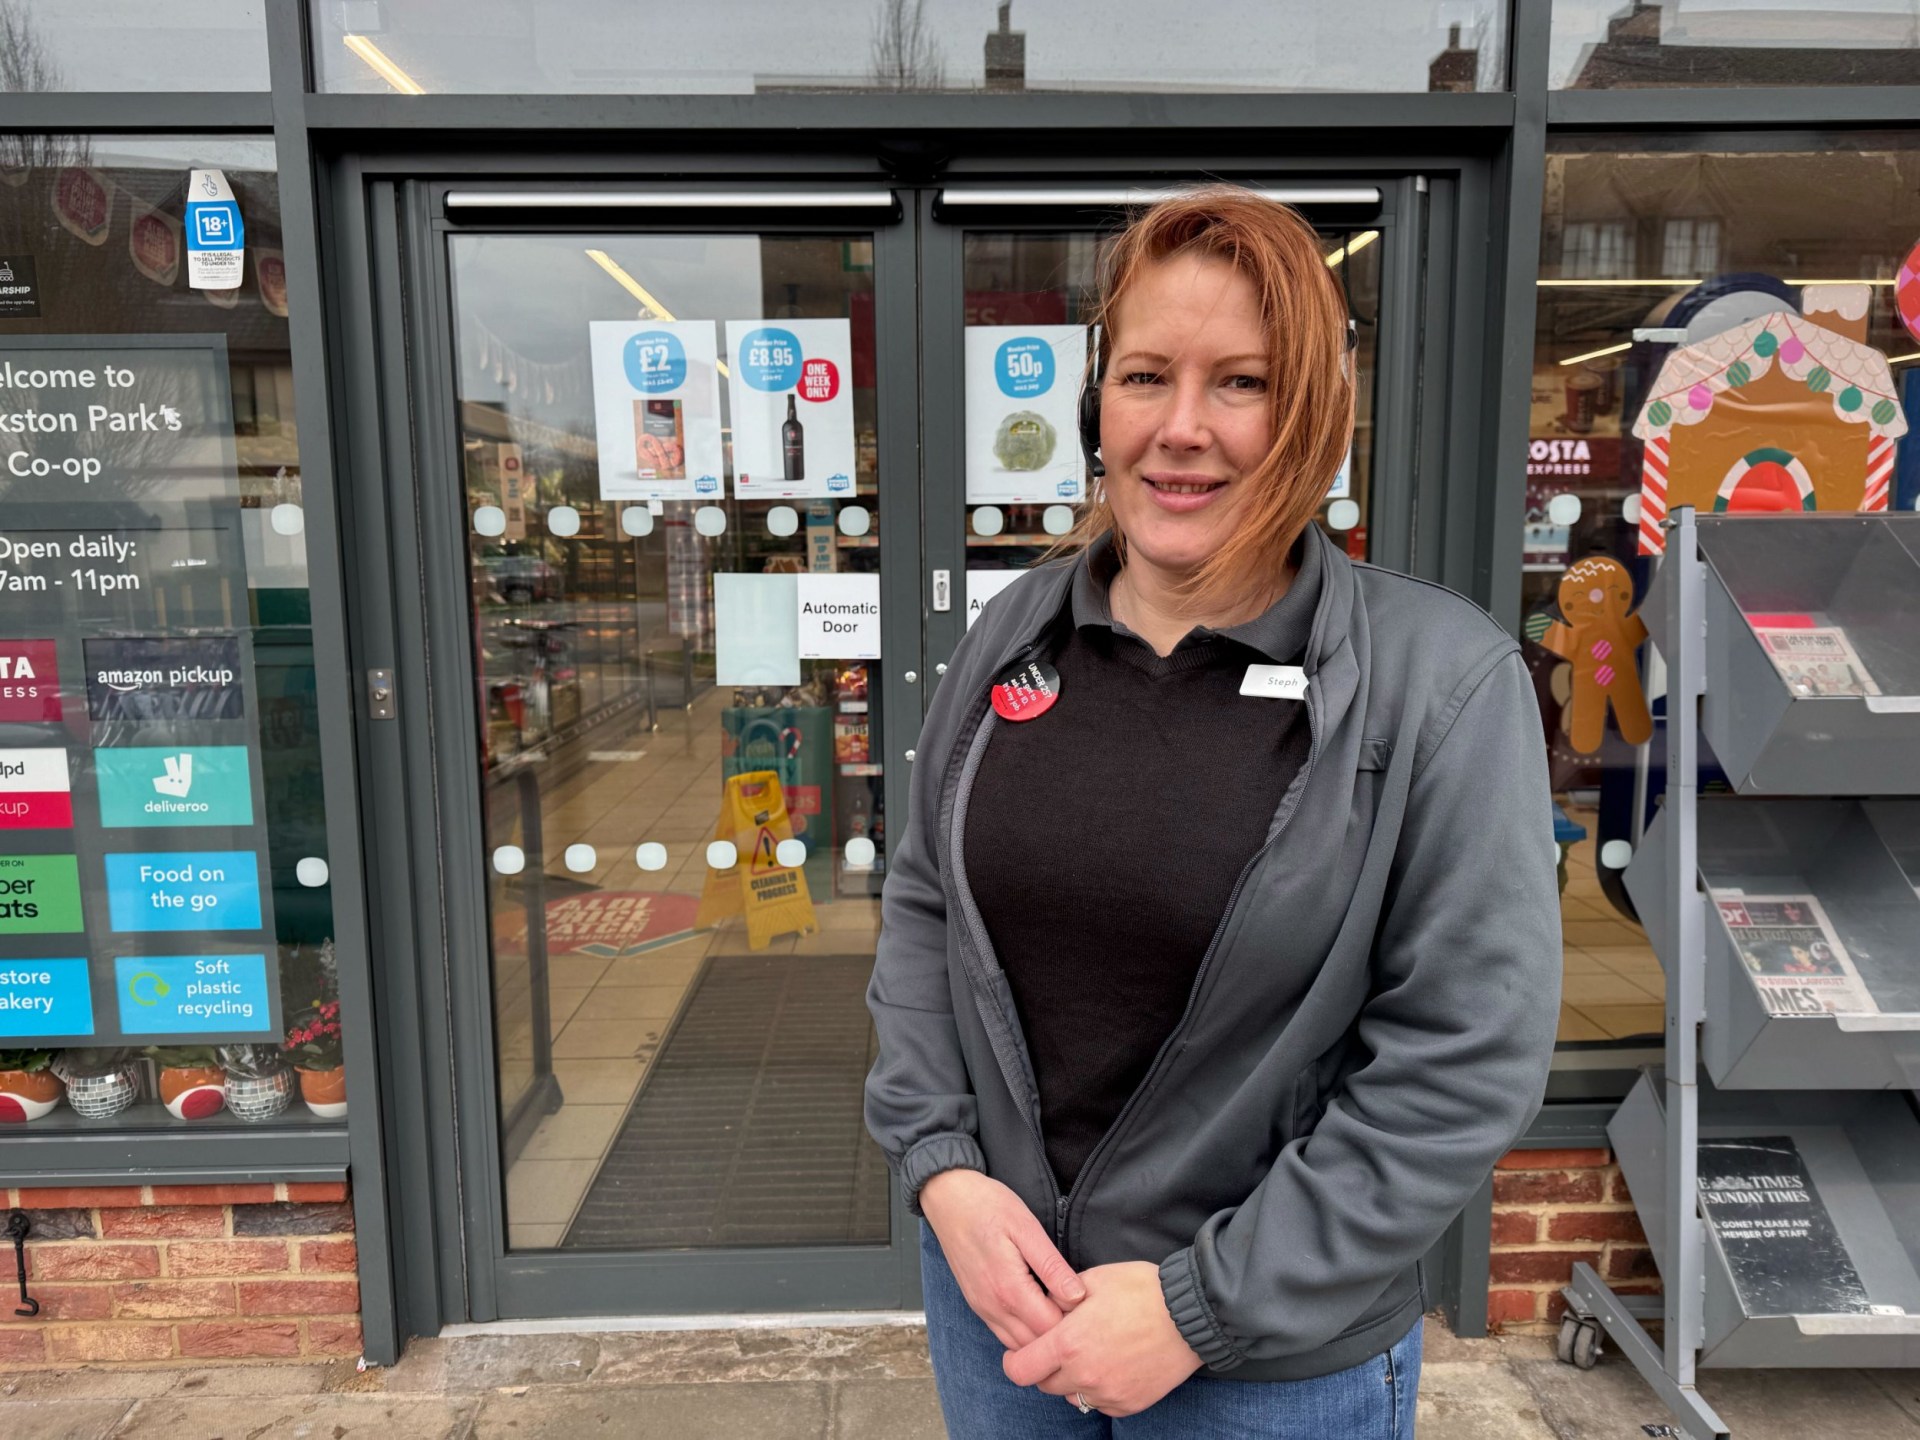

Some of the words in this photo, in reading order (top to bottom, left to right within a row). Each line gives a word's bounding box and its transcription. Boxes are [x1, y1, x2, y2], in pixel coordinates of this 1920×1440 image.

[201, 216, 228, 232] 18+
[640, 345, 671, 372] £2
[748, 347, 794, 367] £8.95
[1007, 353, 1042, 377] 50p
[0, 361, 96, 388] lcome
[104, 365, 135, 388] to
[806, 363, 829, 376] ONE
[804, 375, 832, 387] WEEK
[805, 386, 830, 399] ONLY
[1528, 440, 1591, 462] OSTA
[8, 450, 101, 483] Co-op
[1527, 463, 1591, 475] EXPRESS
[0, 536, 61, 565] Open
[69, 534, 136, 563] daily:
[0, 569, 47, 591] 7am
[71, 569, 140, 596] 11pm
[802, 602, 878, 615] Automatic
[823, 620, 859, 633] Door
[0, 656, 36, 679] TA
[98, 670, 163, 684] amazon
[170, 665, 233, 687] pickup
[1028, 662, 1046, 687] UNDER
[1267, 676, 1299, 688] Steph
[3, 686, 38, 698] ESS
[144, 800, 209, 813] deliveroo
[11, 859, 25, 868] ON
[140, 865, 194, 883] Food
[199, 867, 225, 883] on
[750, 873, 788, 891] CLEANING
[151, 890, 185, 909] the
[190, 893, 218, 912] go
[757, 883, 798, 902] PROGRESS
[546, 922, 649, 935] ATCH
[195, 960, 230, 975] Soft
[0, 969, 51, 985] store
[186, 979, 242, 998] plastic
[0, 992, 54, 1014] akery
[177, 1000, 253, 1018] recycling
[1748, 1175, 1804, 1189] TIMES
[1708, 1191, 1765, 1204] SUNDAY
[1764, 1190, 1811, 1203] TIMES
[1721, 1220, 1753, 1229] GONE?
[1754, 1219, 1792, 1228] PLEASE
[1792, 1219, 1812, 1228] ASK
[1721, 1230, 1761, 1239] MEMBER
[1763, 1230, 1777, 1238] OF
[1778, 1229, 1809, 1238] STAFF
